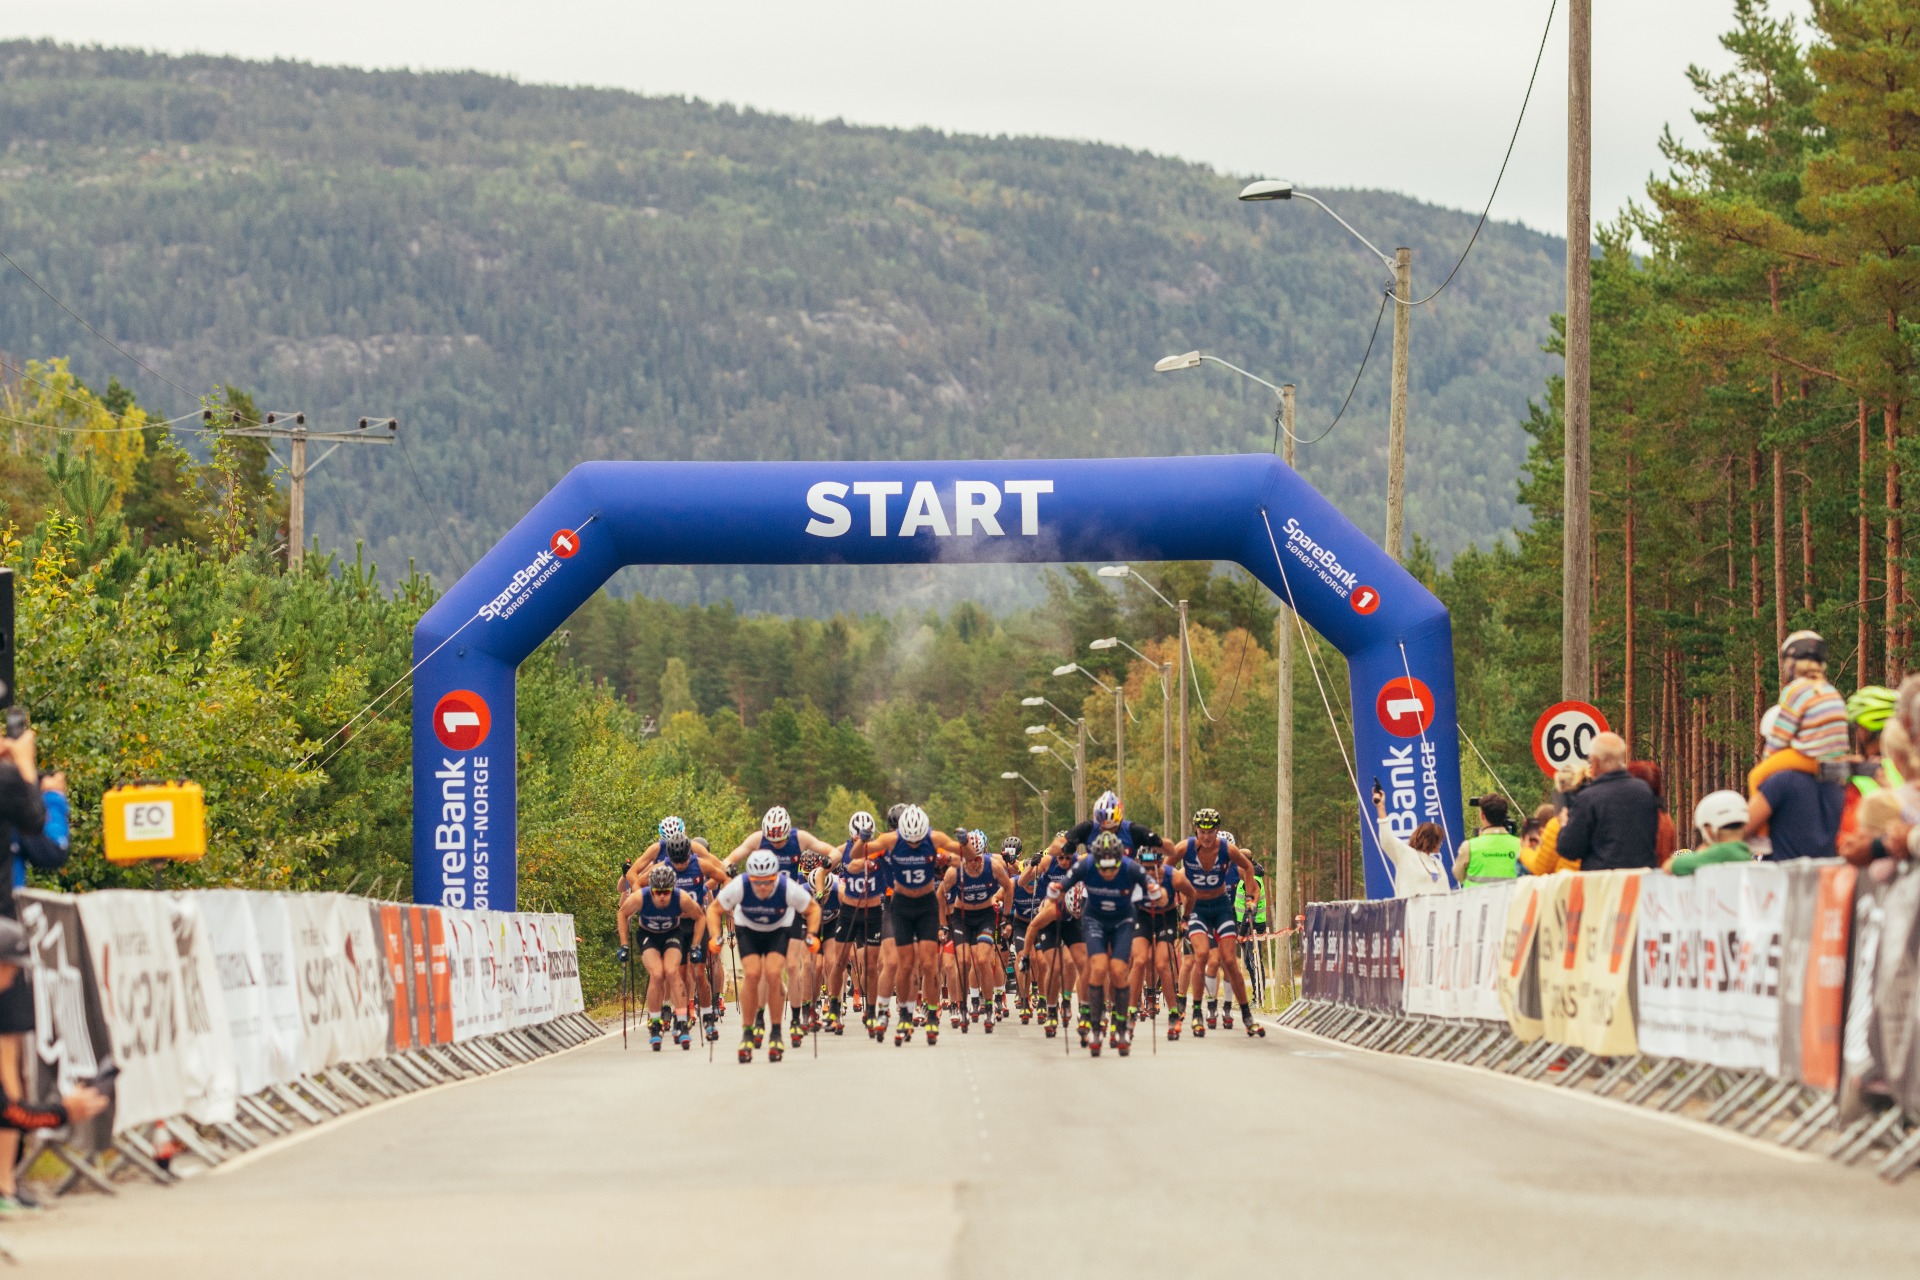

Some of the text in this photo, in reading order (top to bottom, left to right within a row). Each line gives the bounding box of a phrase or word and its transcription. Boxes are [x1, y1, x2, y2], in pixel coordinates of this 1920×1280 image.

[805, 480, 1053, 537] START
[1282, 518, 1358, 590] SpareBank
[1285, 541, 1349, 598] SØRØST-NORGE
[478, 550, 554, 621] SpareBank
[501, 560, 562, 620] SØRØST-NORGE
[1546, 722, 1597, 762] 60
[1382, 743, 1418, 846] Bank
[435, 757, 466, 908] areBank
[474, 757, 489, 911] ØRØST-NORGE
[847, 877, 876, 893] 101
[902, 869, 926, 884] 13
[1193, 873, 1219, 886] 26
